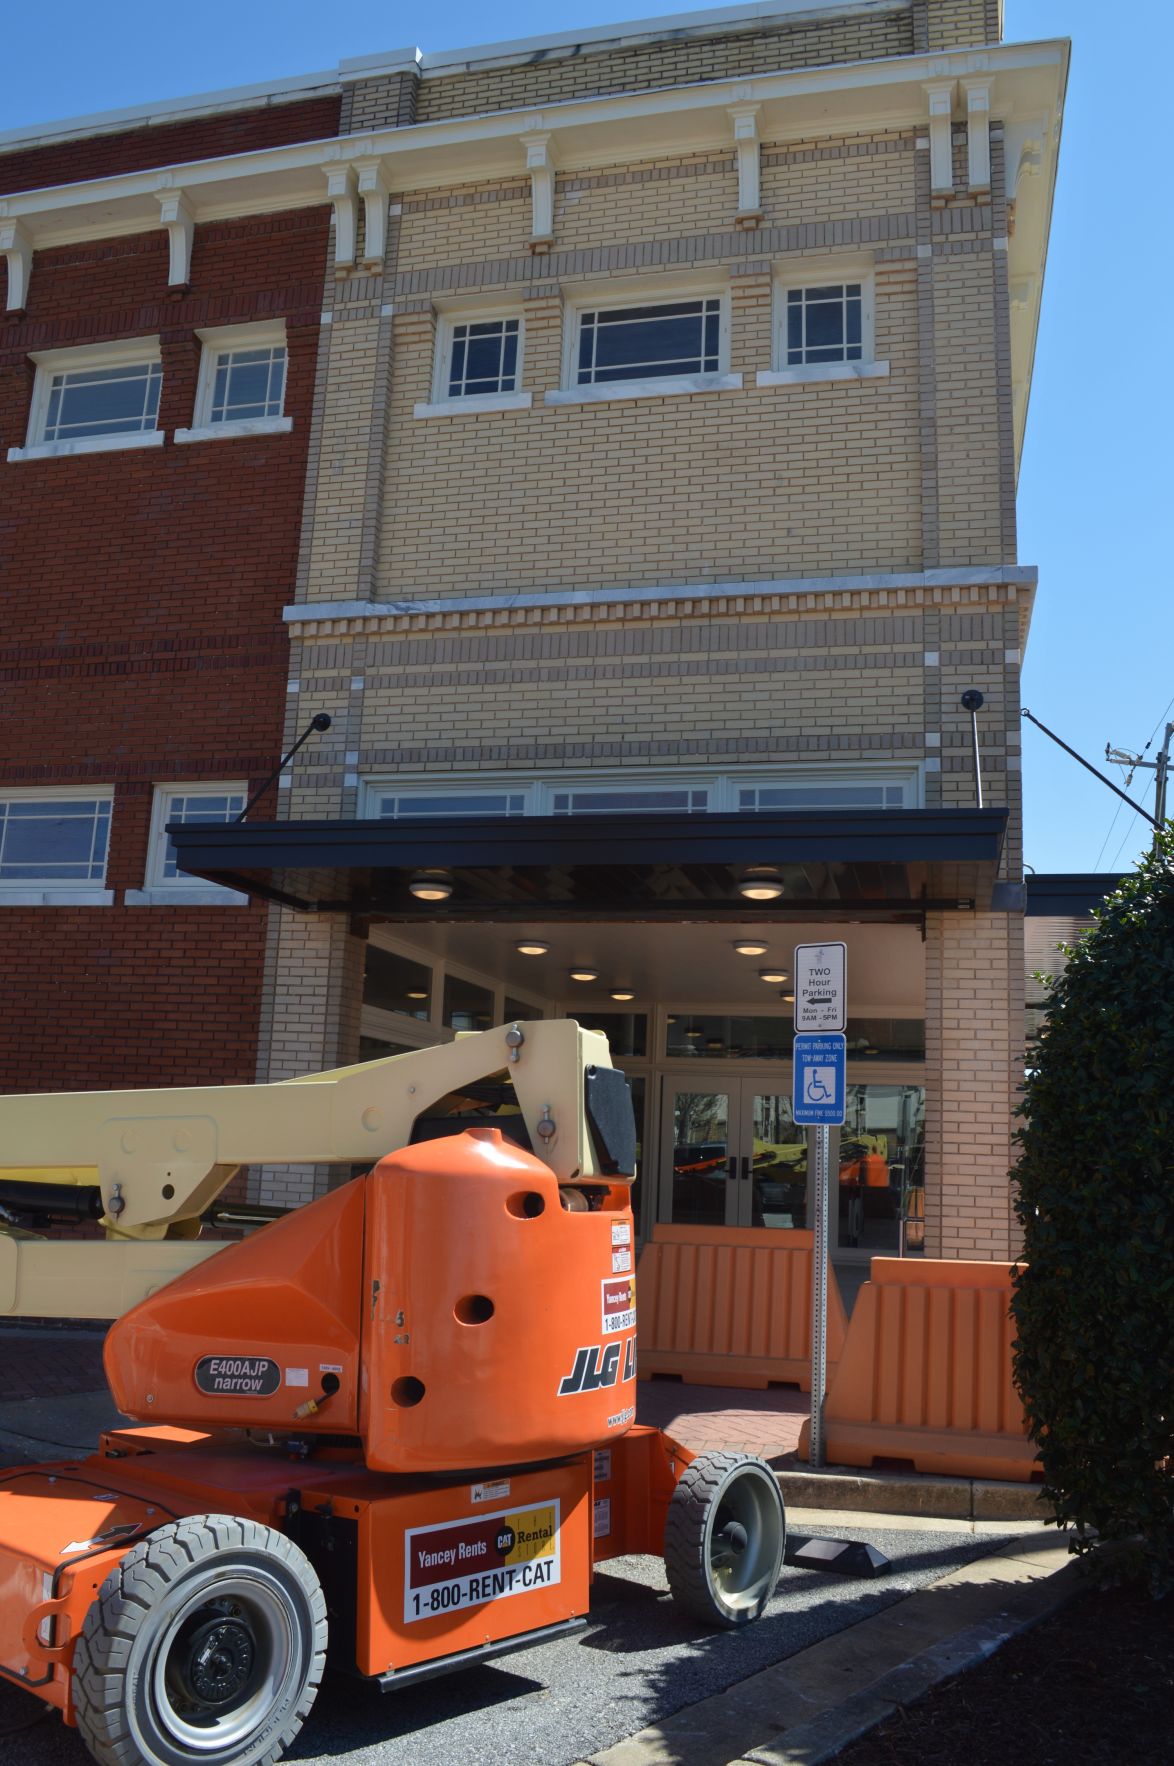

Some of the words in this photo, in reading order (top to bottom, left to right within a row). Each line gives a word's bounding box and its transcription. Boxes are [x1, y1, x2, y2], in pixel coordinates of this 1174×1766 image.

[808, 968, 831, 976] TWO
[808, 978, 831, 987] Hour
[802, 988, 837, 998] Parking
[795, 1042, 811, 1050] PERMIT
[812, 1042, 831, 1050] PARKING
[832, 1041, 844, 1050] ONLY
[825, 1054, 838, 1062] ZONE
[209, 1359, 269, 1376] E400AJP
[557, 1341, 622, 1397] JLG
[214, 1376, 263, 1391] narrow
[418, 1548, 456, 1568] Yancey
[458, 1540, 487, 1560] Rents
[497, 1533, 512, 1549] CAT
[517, 1525, 553, 1543] Rental
[412, 1560, 554, 1616] 1-800-RENT-CAT
